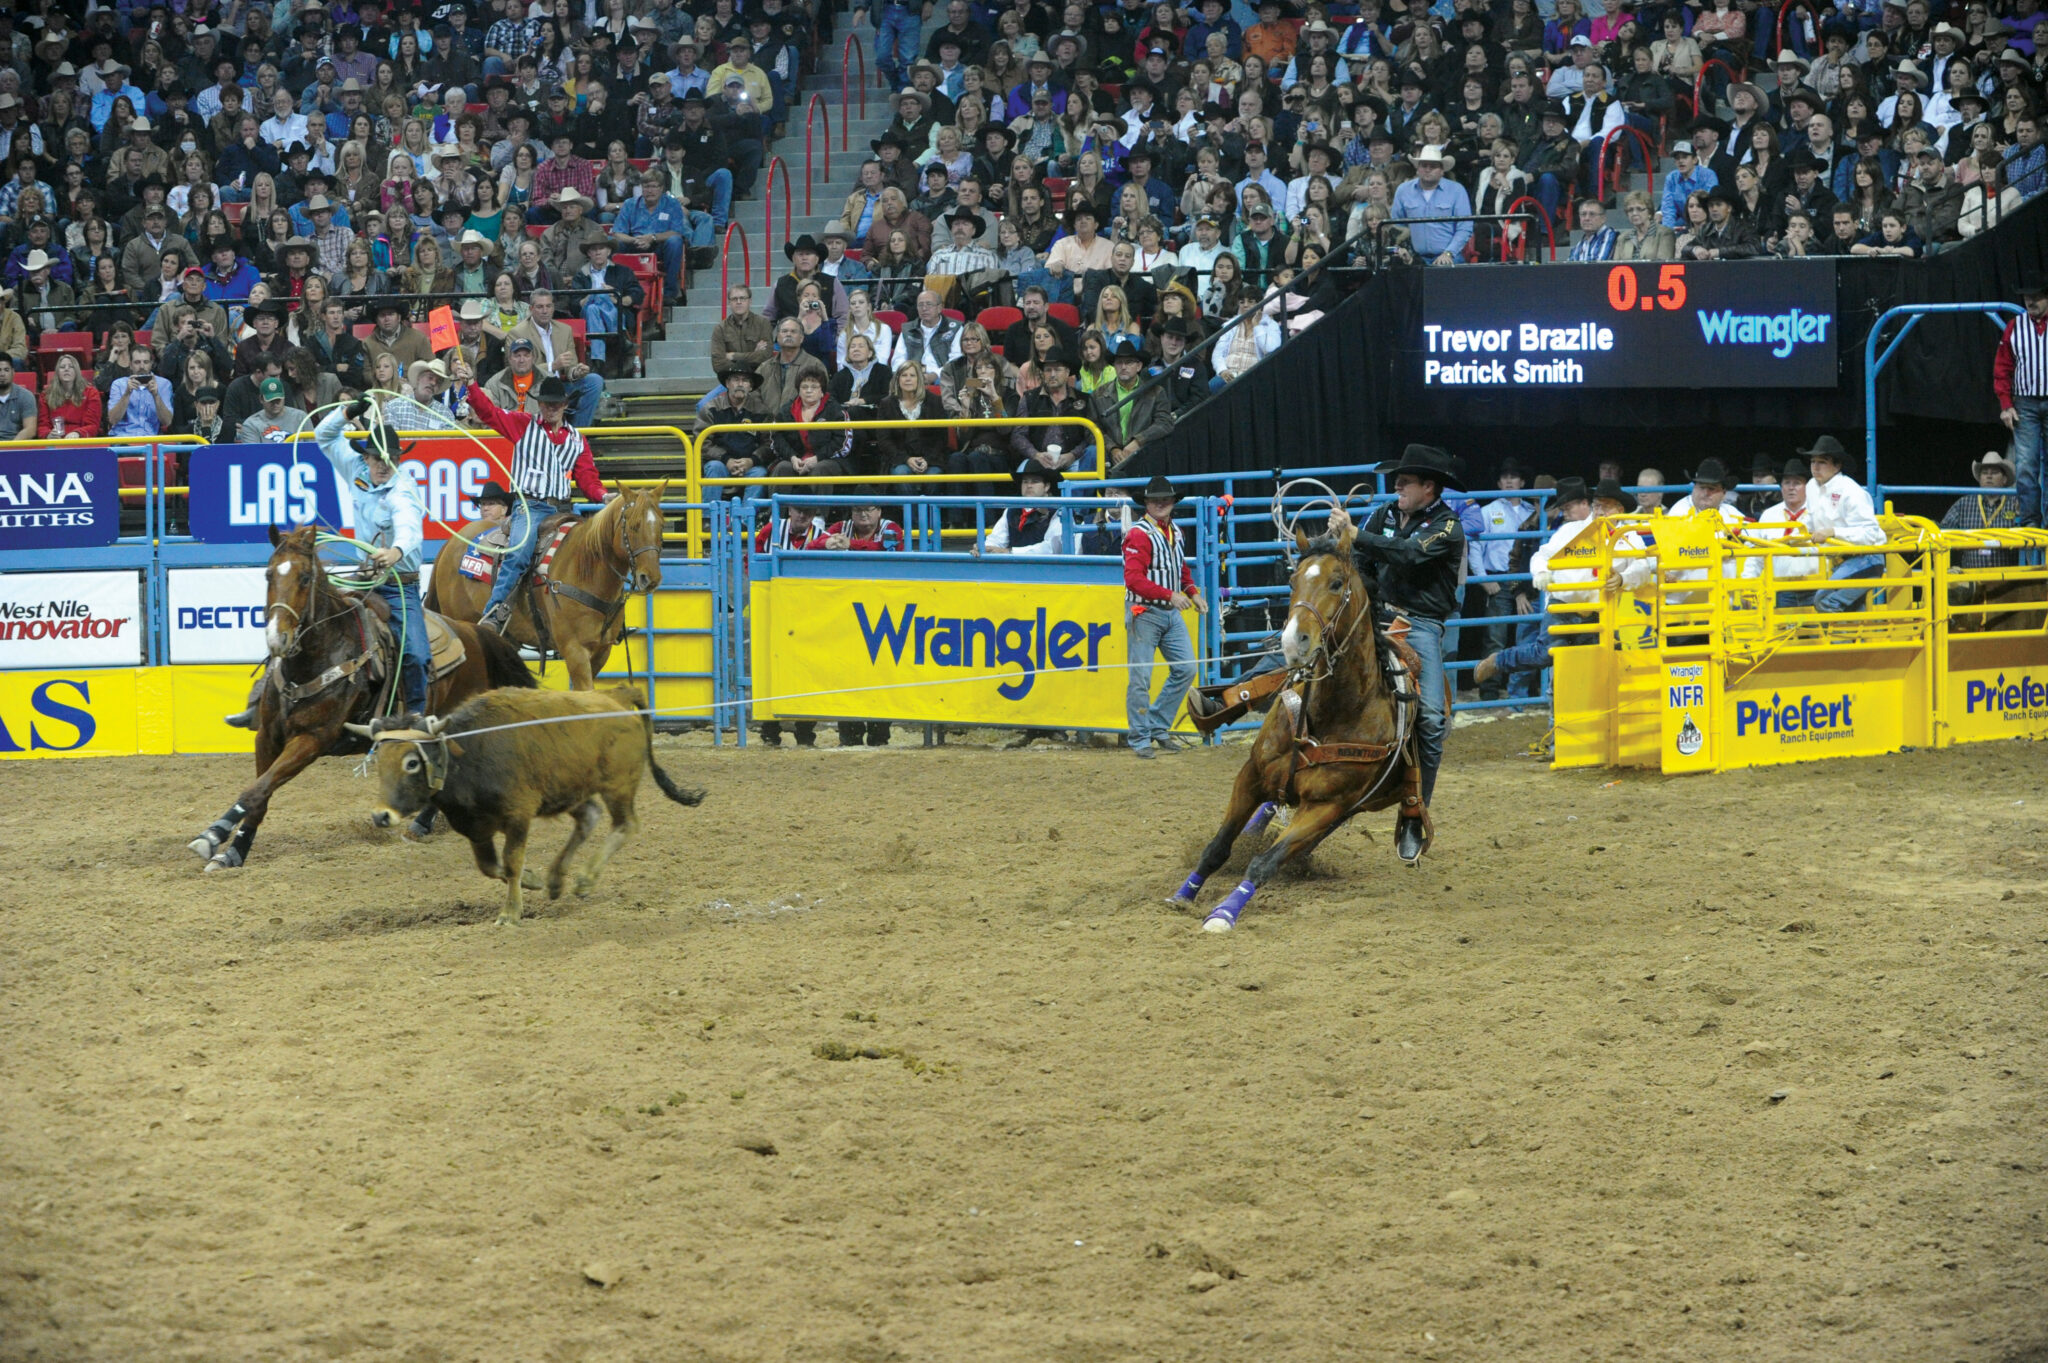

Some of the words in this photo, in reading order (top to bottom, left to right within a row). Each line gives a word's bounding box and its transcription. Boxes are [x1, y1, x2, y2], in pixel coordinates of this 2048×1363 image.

[1608, 264, 1687, 310] 0.5
[1423, 325, 1512, 352] Trevor
[1519, 322, 1614, 351] Brazile
[1697, 308, 1831, 358] Wrangler
[1425, 359, 1507, 384] Patrick
[1513, 358, 1584, 383] Smith
[228, 463, 318, 526] LAS
[1564, 545, 1597, 556] Priefert
[1679, 545, 1709, 557] Priefert
[461, 557, 482, 572] NFR
[47, 600, 89, 618] Nile
[0, 613, 128, 640] novator
[852, 602, 1111, 700] Wrangler
[1669, 665, 1703, 682] Wrangler
[1669, 685, 1704, 708] NFR
[1967, 672, 2048, 714] Priefe
[1737, 691, 1852, 736] Priefert
[2004, 711, 2027, 721] Ranch
[1781, 732, 1807, 744] Ranch
[1810, 729, 1854, 743] Equipment
